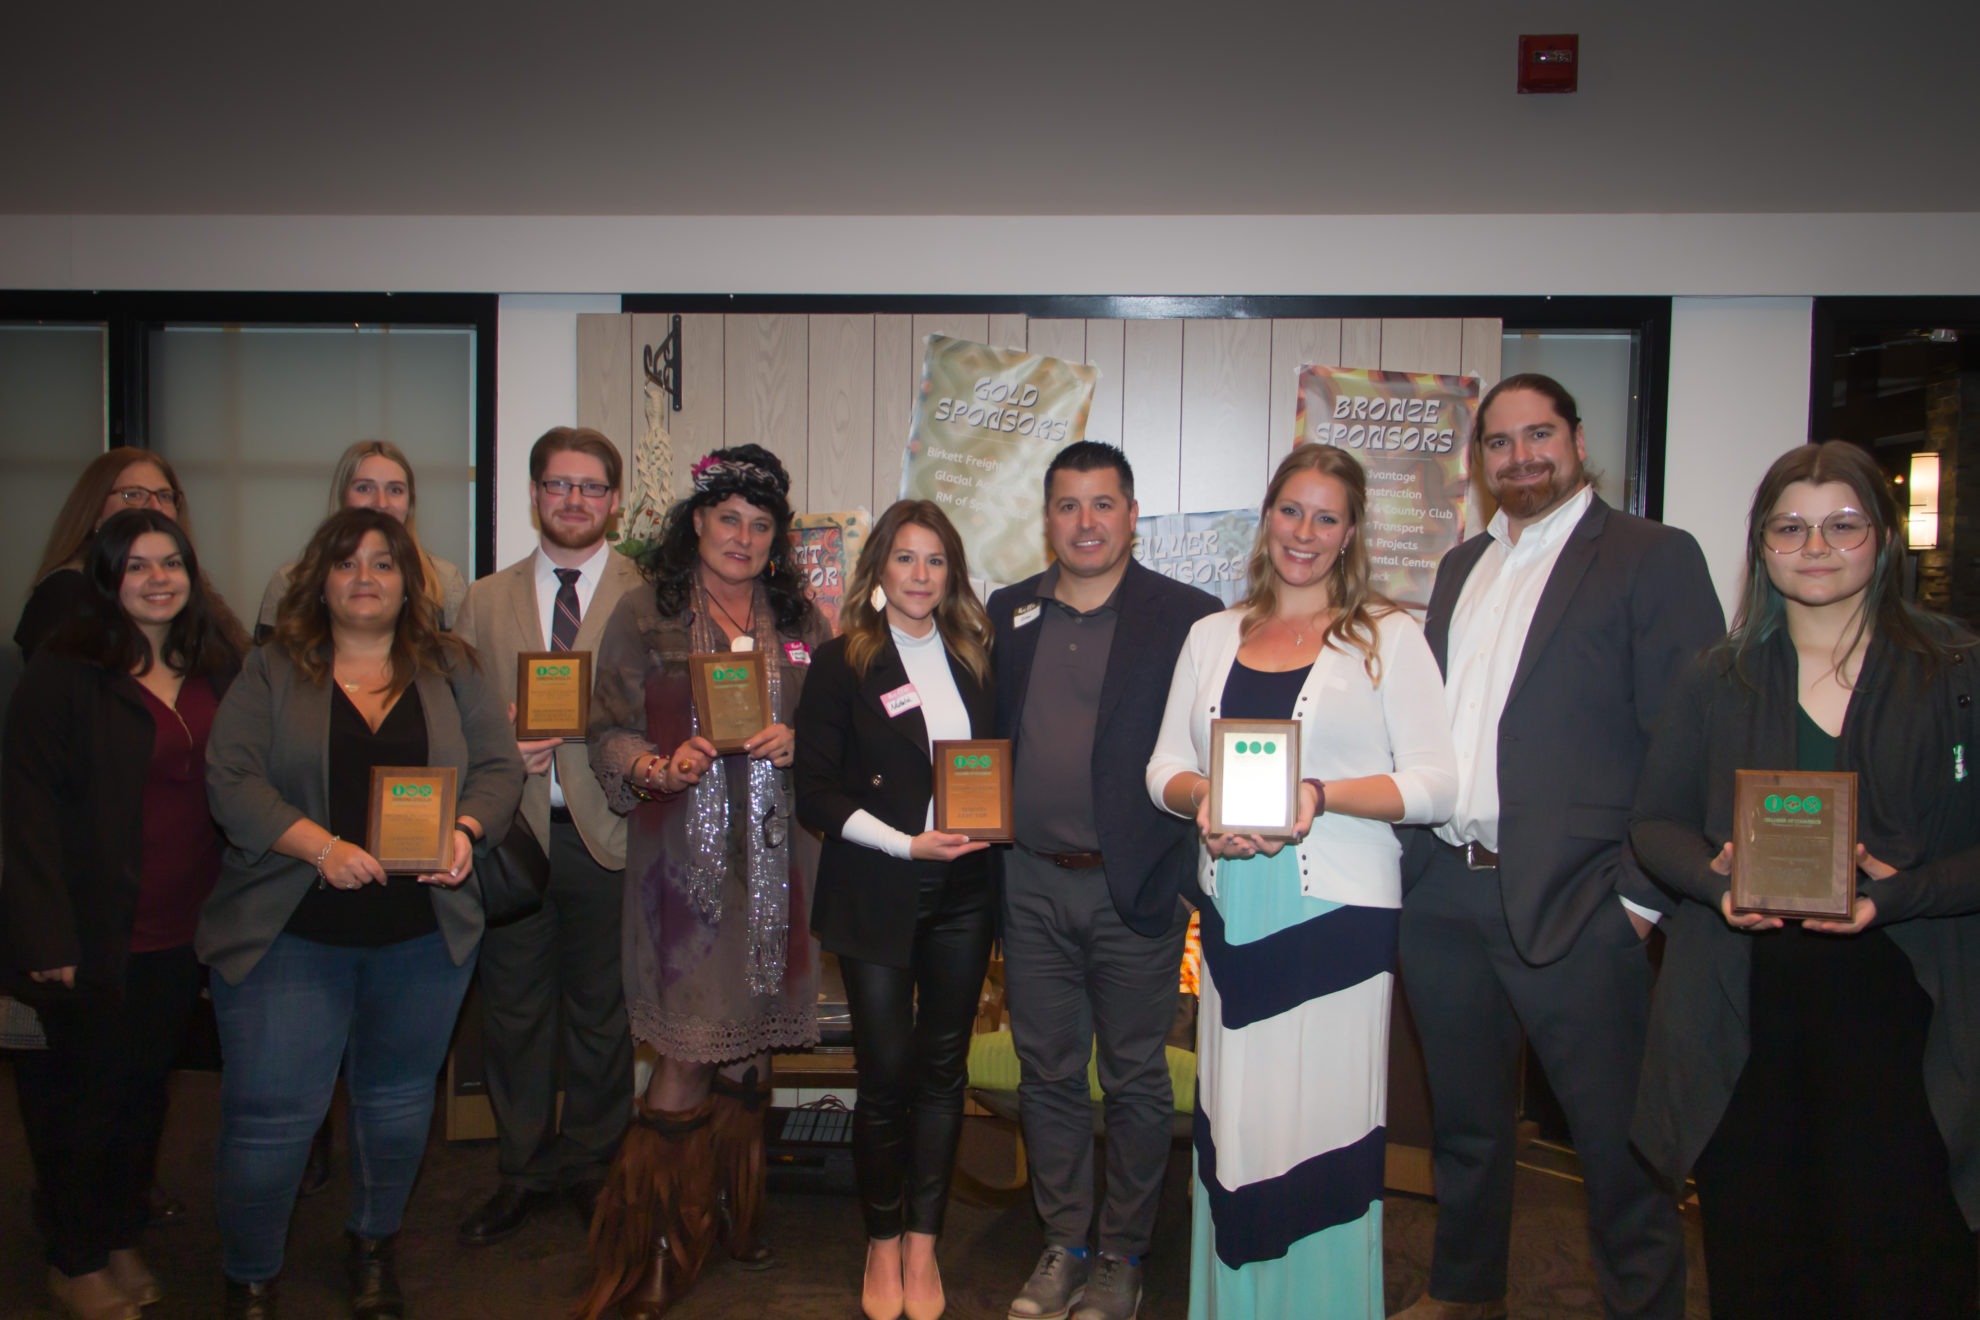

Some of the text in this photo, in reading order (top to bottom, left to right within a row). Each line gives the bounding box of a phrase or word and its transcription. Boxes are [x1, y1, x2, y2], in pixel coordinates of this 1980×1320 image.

[974, 377, 1039, 408] GOLD
[1333, 395, 1441, 424] BRONZE
[934, 397, 1069, 442] SPONSORS
[1315, 422, 1455, 454] SPONSORS
[927, 446, 1002, 473] Birkett Freigh
[934, 470, 973, 488] Glacial
[1366, 469, 1416, 484] dvantage
[935, 491, 969, 506] RM of
[1383, 504, 1426, 519] Country
[1429, 508, 1453, 519] Club
[1373, 520, 1424, 534] Transport
[1376, 538, 1418, 551] Projects
[1158, 554, 1248, 584] NSORS
[1371, 556, 1437, 569] ental Centre
